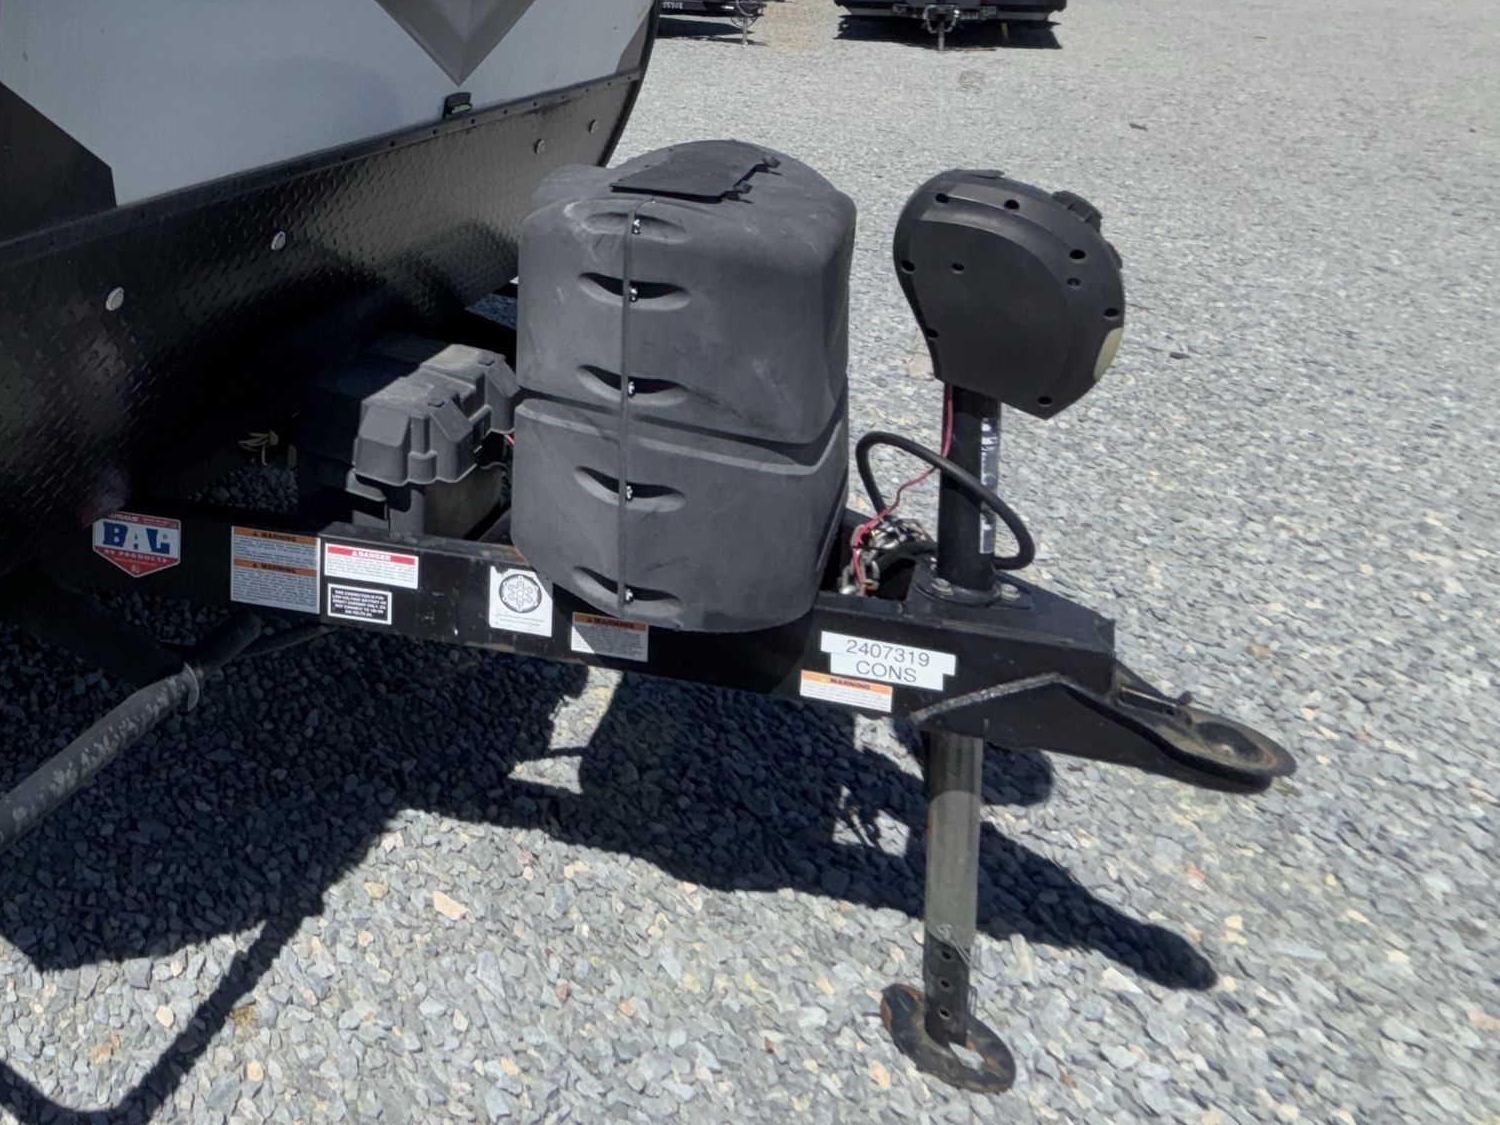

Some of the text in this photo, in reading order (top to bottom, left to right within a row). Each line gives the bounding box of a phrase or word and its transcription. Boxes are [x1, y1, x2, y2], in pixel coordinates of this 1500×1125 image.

[102, 521, 170, 555] BAL
[260, 531, 297, 543] WARNING
[103, 548, 116, 556] RV
[118, 551, 168, 563] PRODUCTS
[358, 550, 392, 562] DANGER
[260, 563, 297, 574] WARNING
[846, 639, 930, 667] 2407319
[856, 661, 917, 683] CONS
[829, 677, 871, 690] WARNING
